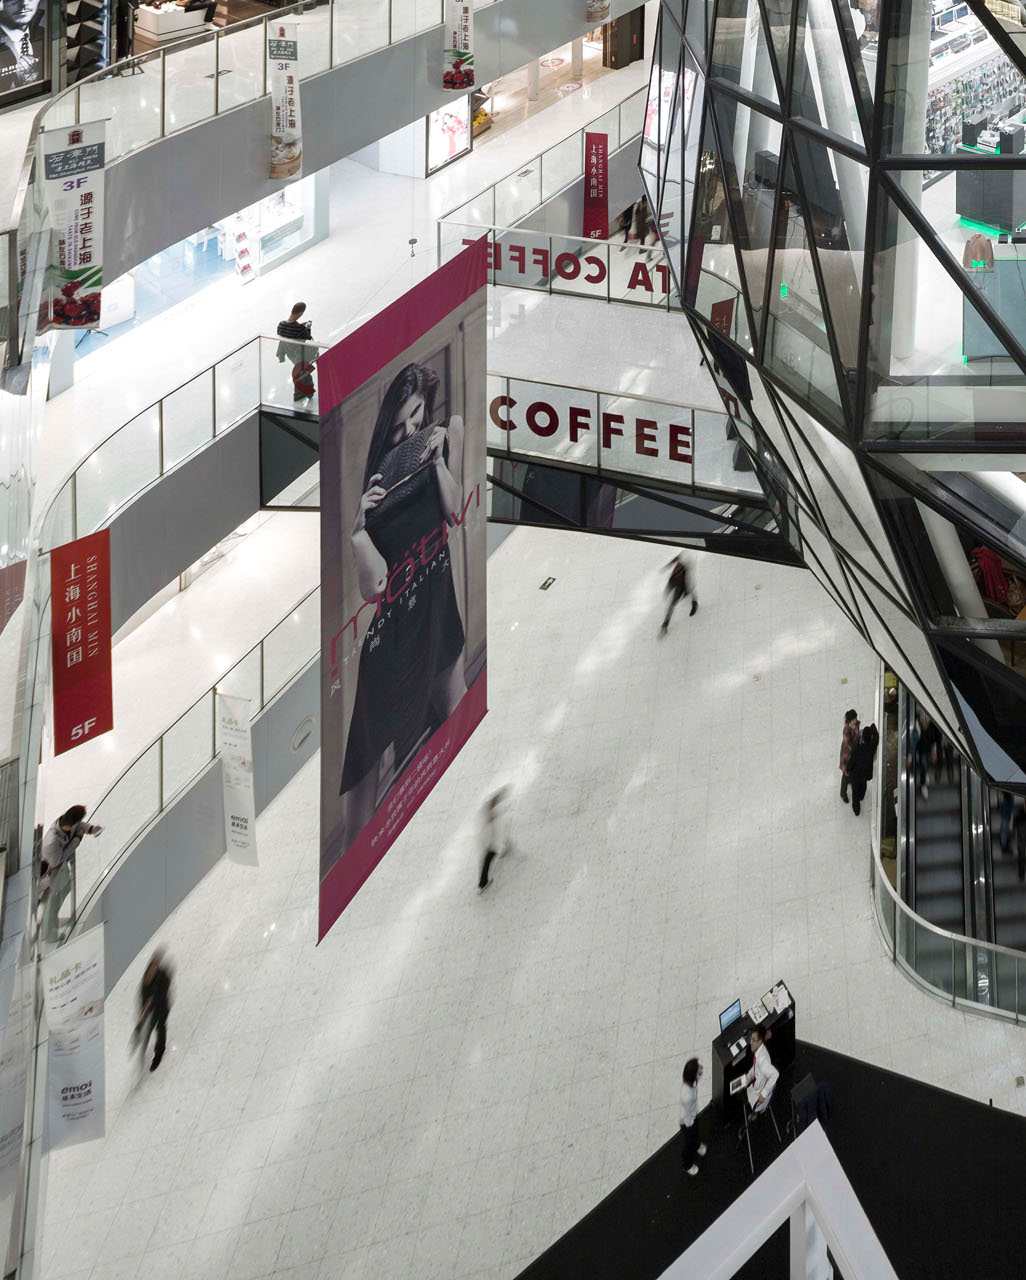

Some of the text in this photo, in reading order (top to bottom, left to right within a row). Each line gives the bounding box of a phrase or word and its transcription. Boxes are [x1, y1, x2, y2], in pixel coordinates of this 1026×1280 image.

[277, 62, 291, 71] 3F
[63, 176, 88, 191] 3F
[79, 191, 94, 265] 源于老上海
[489, 395, 693, 464] COFFEE
[64, 563, 83, 669] 上海小南国
[86, 554, 99, 658] SHANGHAI MIN
[70, 716, 96, 741] 5F
[61, 1079, 93, 1096] emoi
